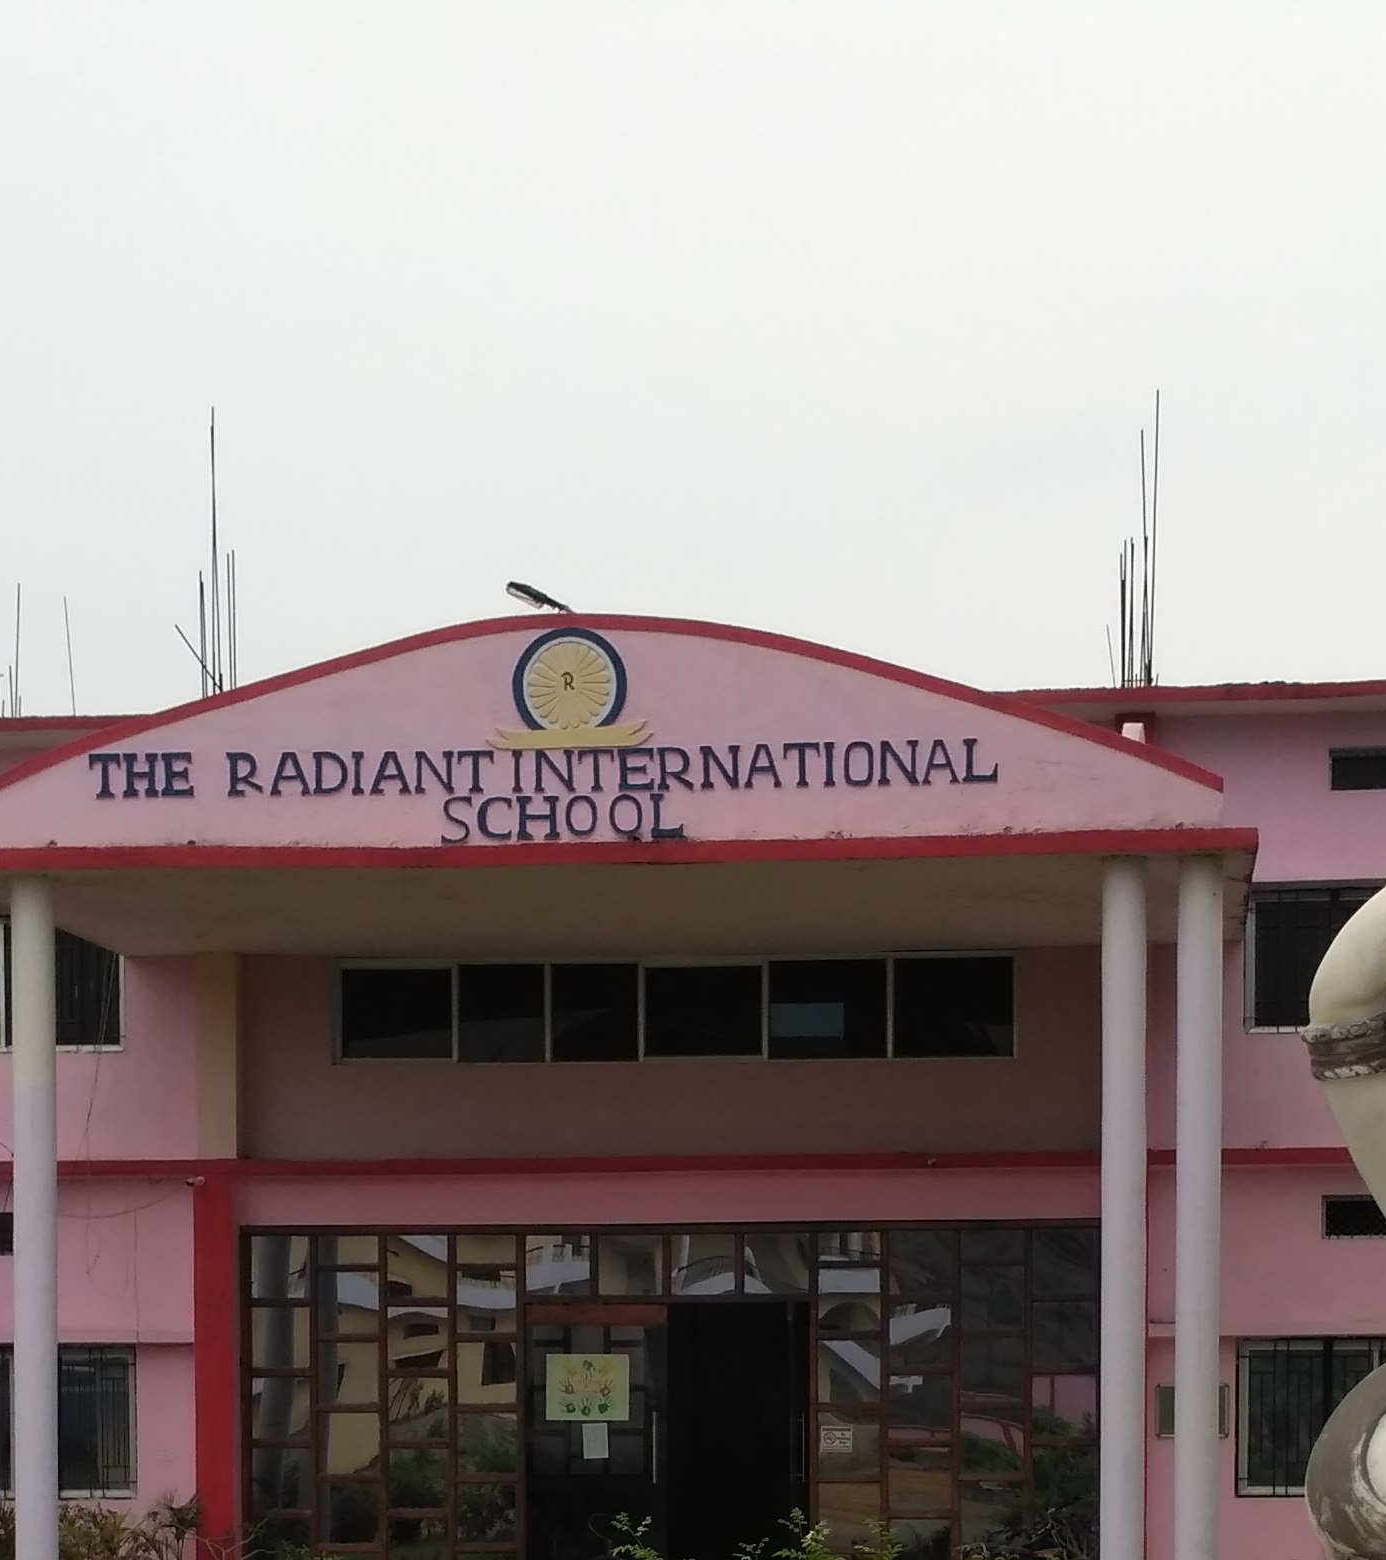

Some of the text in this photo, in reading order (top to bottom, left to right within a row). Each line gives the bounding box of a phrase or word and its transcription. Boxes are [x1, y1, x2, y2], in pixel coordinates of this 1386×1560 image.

[89, 738, 999, 799] THE RADIANT INTERNATIONAL
[441, 793, 684, 843] SCHOOL
